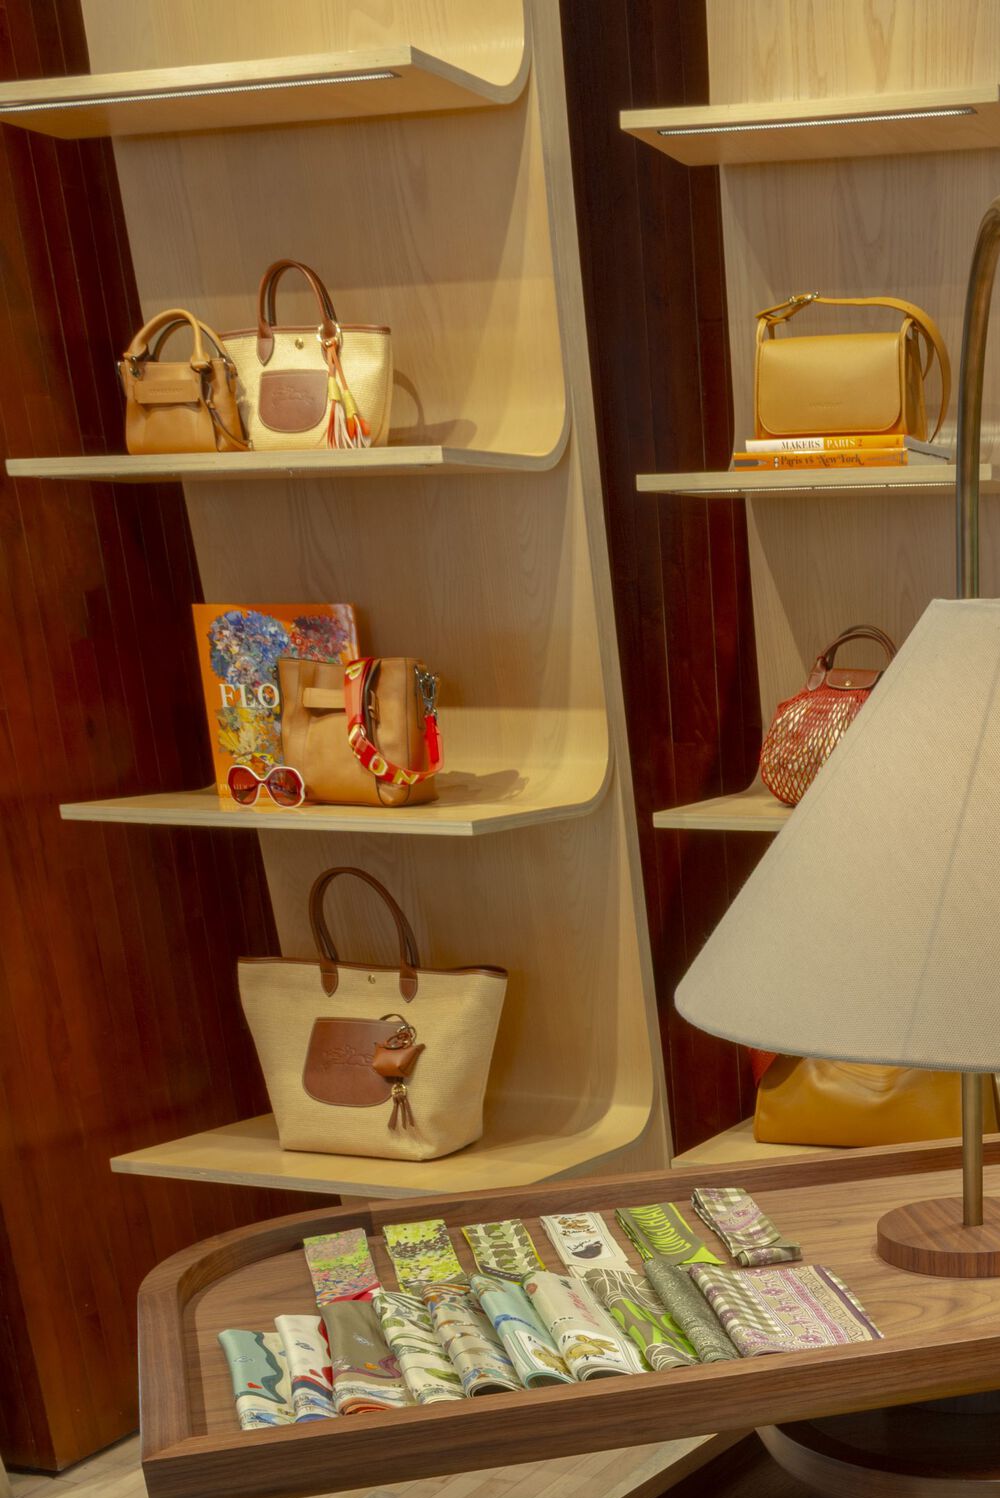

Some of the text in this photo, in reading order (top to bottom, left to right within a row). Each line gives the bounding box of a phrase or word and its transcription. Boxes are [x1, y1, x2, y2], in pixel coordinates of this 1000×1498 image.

[781, 439, 821, 450] MAKERS
[826, 438, 856, 449] PARIS
[780, 455, 802, 467] Paris
[218, 682, 279, 708] FLO
